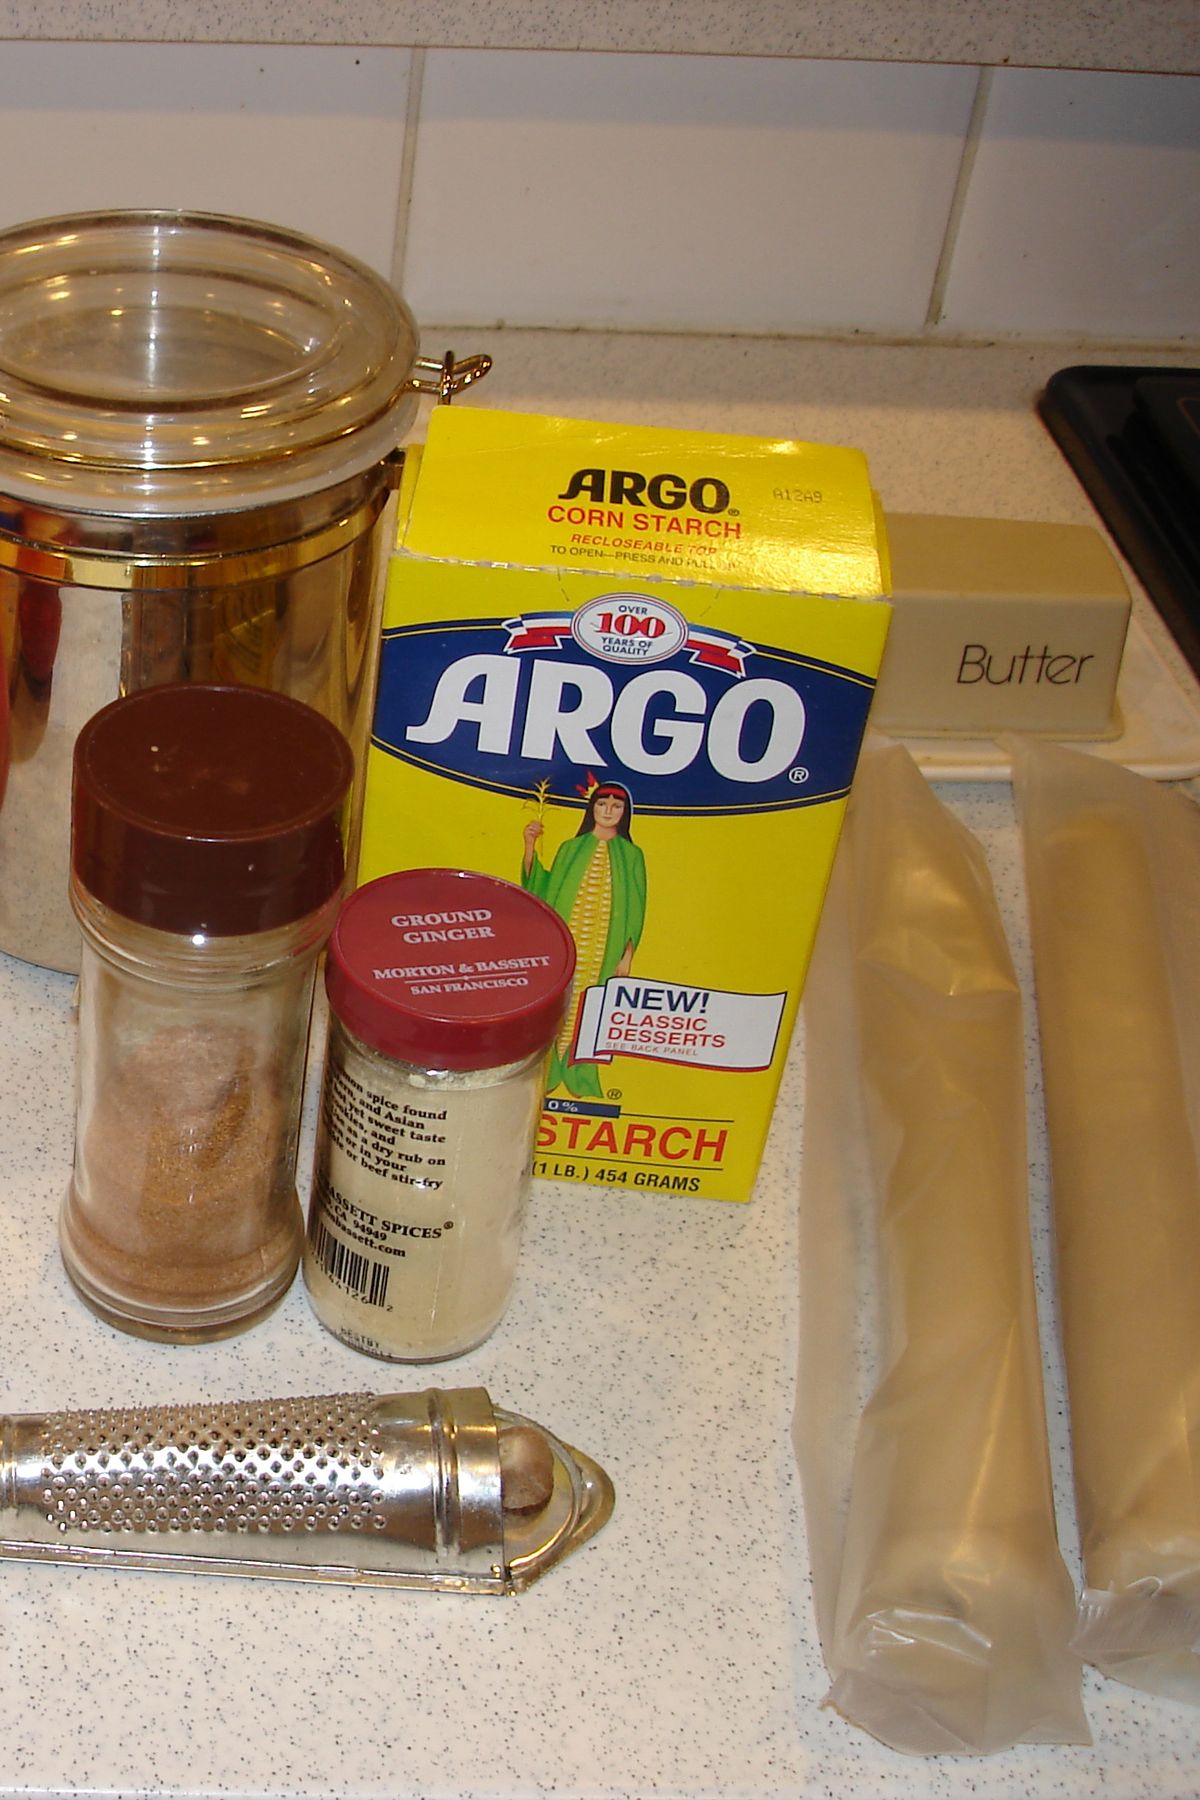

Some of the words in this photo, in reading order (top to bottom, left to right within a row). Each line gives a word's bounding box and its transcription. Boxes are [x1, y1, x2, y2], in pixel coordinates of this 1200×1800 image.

[558, 468, 731, 514] ARGO
[547, 505, 624, 529] CORN
[633, 513, 742, 539] STARCH
[550, 544, 566, 554] TO
[658, 556, 683, 566] AND
[571, 533, 683, 554] RECLOSEABLE
[618, 605, 648, 615] OVER
[596, 612, 666, 638] 100
[601, 637, 635, 647] YEARS
[638, 640, 653, 649] OF
[602, 644, 649, 656] QUALITY
[957, 645, 1094, 685] Butter
[405, 654, 807, 783] ARGO
[391, 909, 493, 928] GROUND
[403, 926, 496, 944] GINGER
[372, 963, 455, 980] MORTON
[476, 955, 551, 972] BASSETT
[410, 984, 442, 996] SAN
[444, 976, 529, 992] FRANCISCO
[614, 985, 710, 1014] NEW!
[610, 1011, 708, 1032] CLASSIC
[607, 1027, 726, 1048] DESSERTS
[630, 1044, 659, 1053] BACK
[663, 1047, 698, 1056] PANEL
[359, 1098, 382, 1116] and
[384, 1111, 425, 1130] Asian
[366, 1090, 399, 1111] spice
[402, 1104, 448, 1120] found
[368, 1117, 406, 1137] sweet
[410, 1131, 446, 1144] taste
[371, 1130, 396, 1145] and
[536, 1114, 728, 1162] STARCH
[360, 1145, 371, 1158] in
[375, 1156, 407, 1172] your
[371, 1141, 393, 1158] dry
[397, 1152, 423, 1164] rub
[428, 1158, 446, 1166] on
[346, 1149, 358, 1162] or
[361, 1158, 389, 1178] beef
[391, 1174, 443, 1190] stir-fry
[595, 1168, 628, 1184] 454
[633, 1174, 701, 1192] GRAMS
[328, 1186, 378, 1226] ASSETT
[381, 1220, 442, 1239] SPICES
[353, 1219, 387, 1241] 94949
